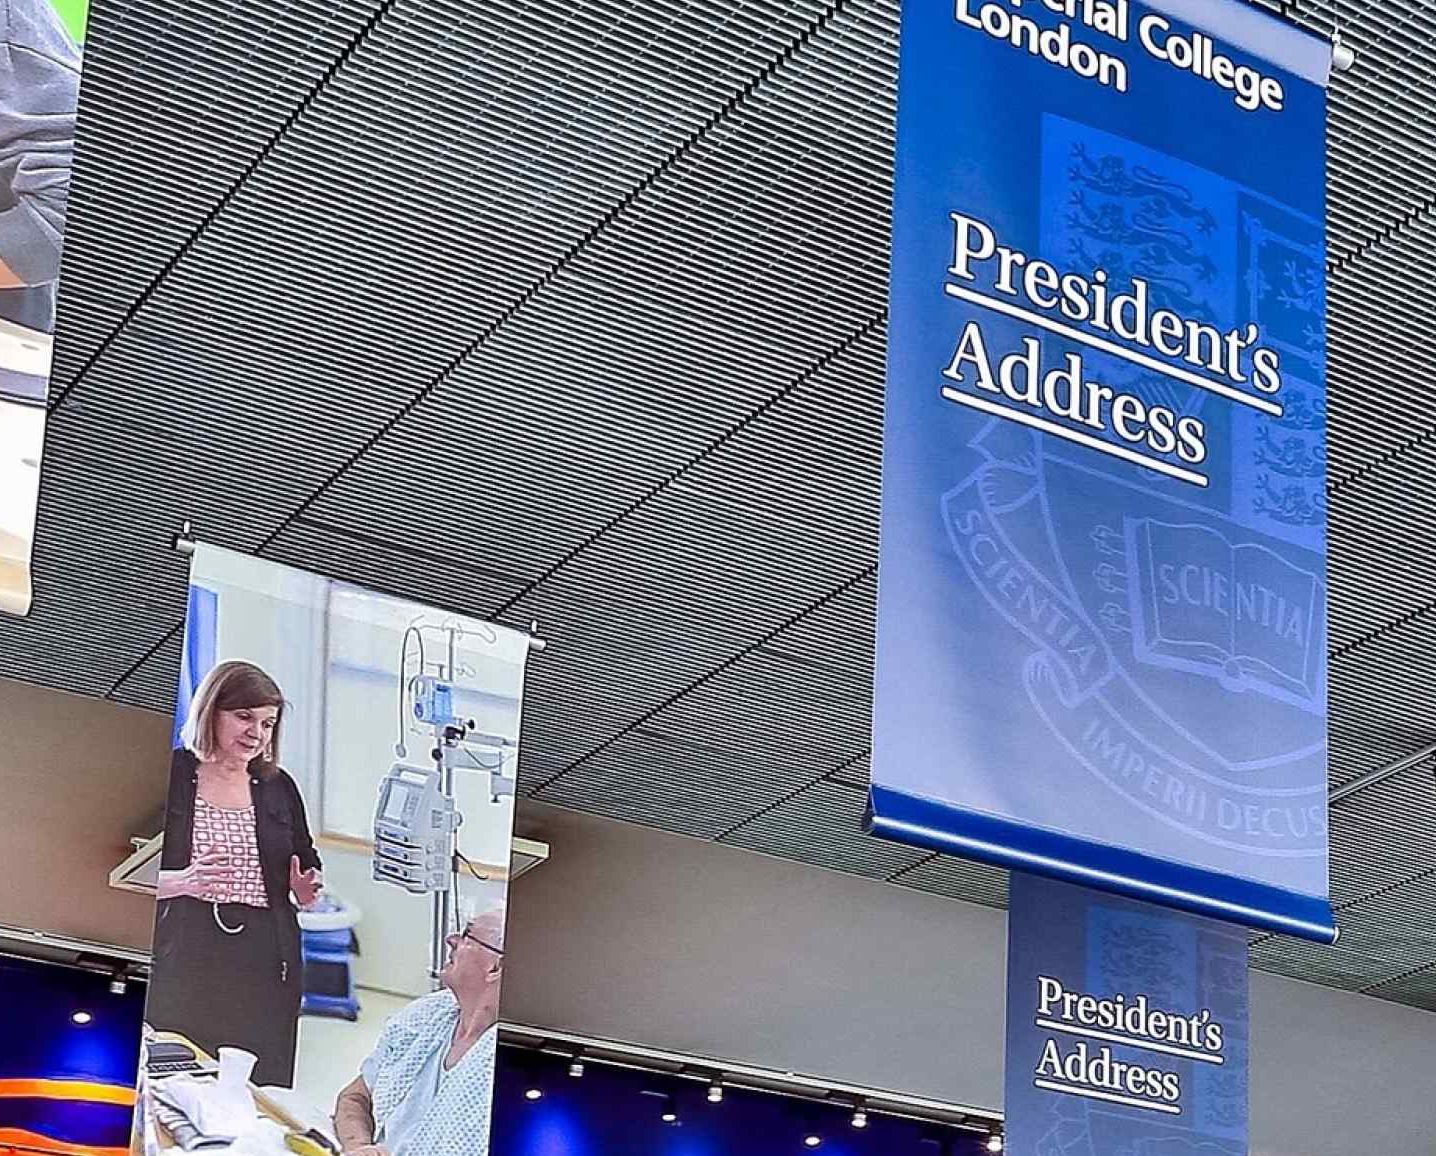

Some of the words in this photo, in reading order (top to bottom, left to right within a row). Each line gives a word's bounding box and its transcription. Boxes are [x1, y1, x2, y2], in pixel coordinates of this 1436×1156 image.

[955, 0, 1128, 92] London
[1139, 14, 1284, 111] College
[949, 212, 1282, 394] President's
[943, 322, 1206, 464] Address
[957, 508, 1098, 674] SCIENTIA
[1160, 563, 1303, 646] SCIENTIA
[1083, 717, 1206, 820] IMPERII
[1218, 798, 1325, 838] DECUS
[1037, 975, 1223, 1051] President's
[1036, 1039, 1180, 1102] Address
